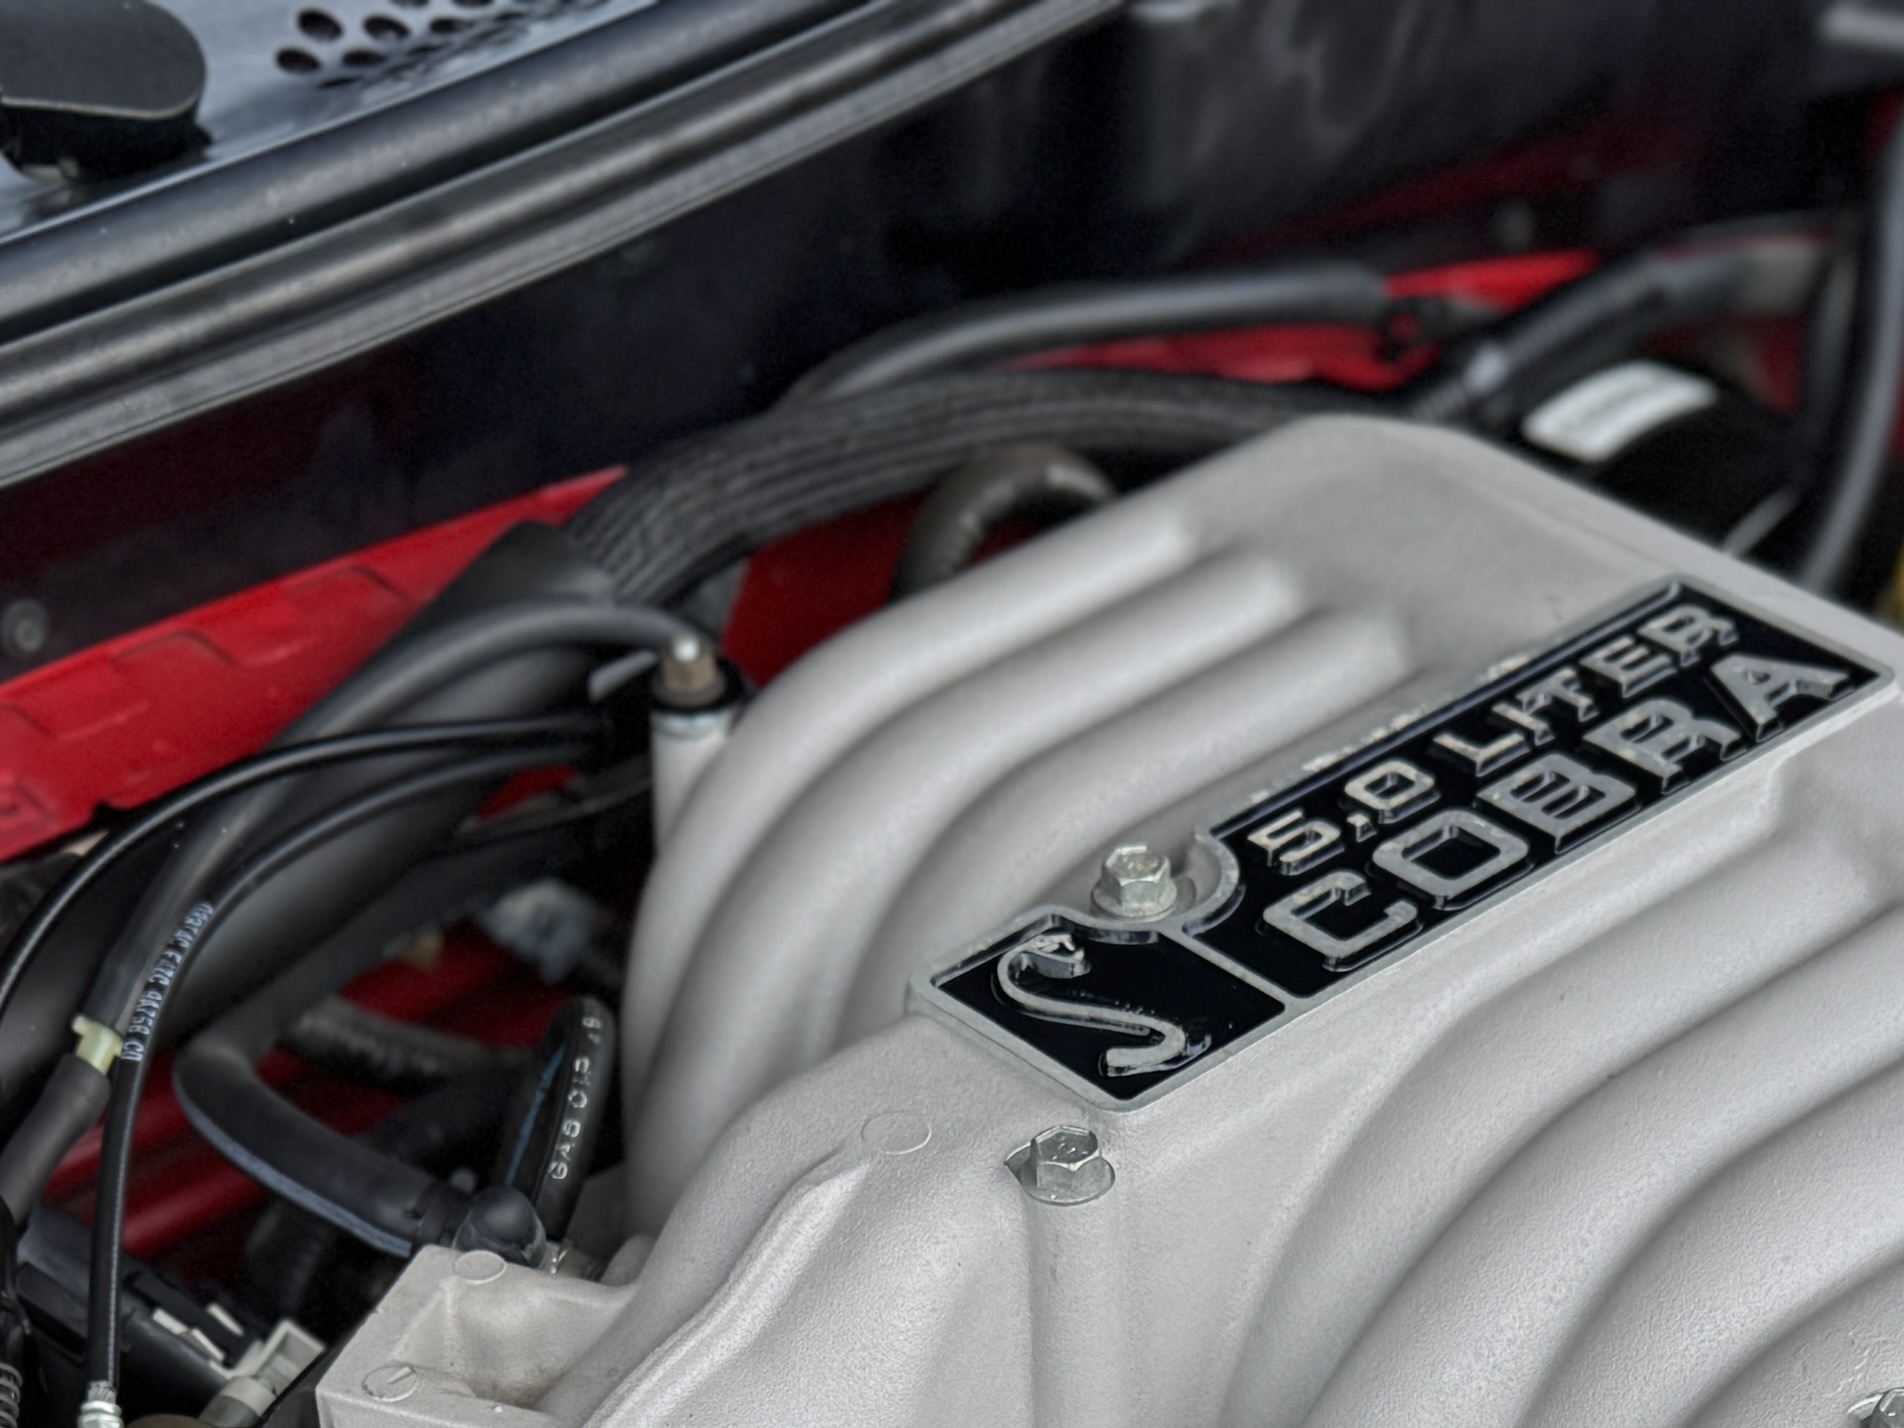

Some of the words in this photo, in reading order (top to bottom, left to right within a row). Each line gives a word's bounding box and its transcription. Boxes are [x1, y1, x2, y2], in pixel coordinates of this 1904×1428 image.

[1246, 756, 1437, 877] 5.0
[1433, 598, 1739, 776] LITER
[1259, 648, 1854, 972] COBRA
